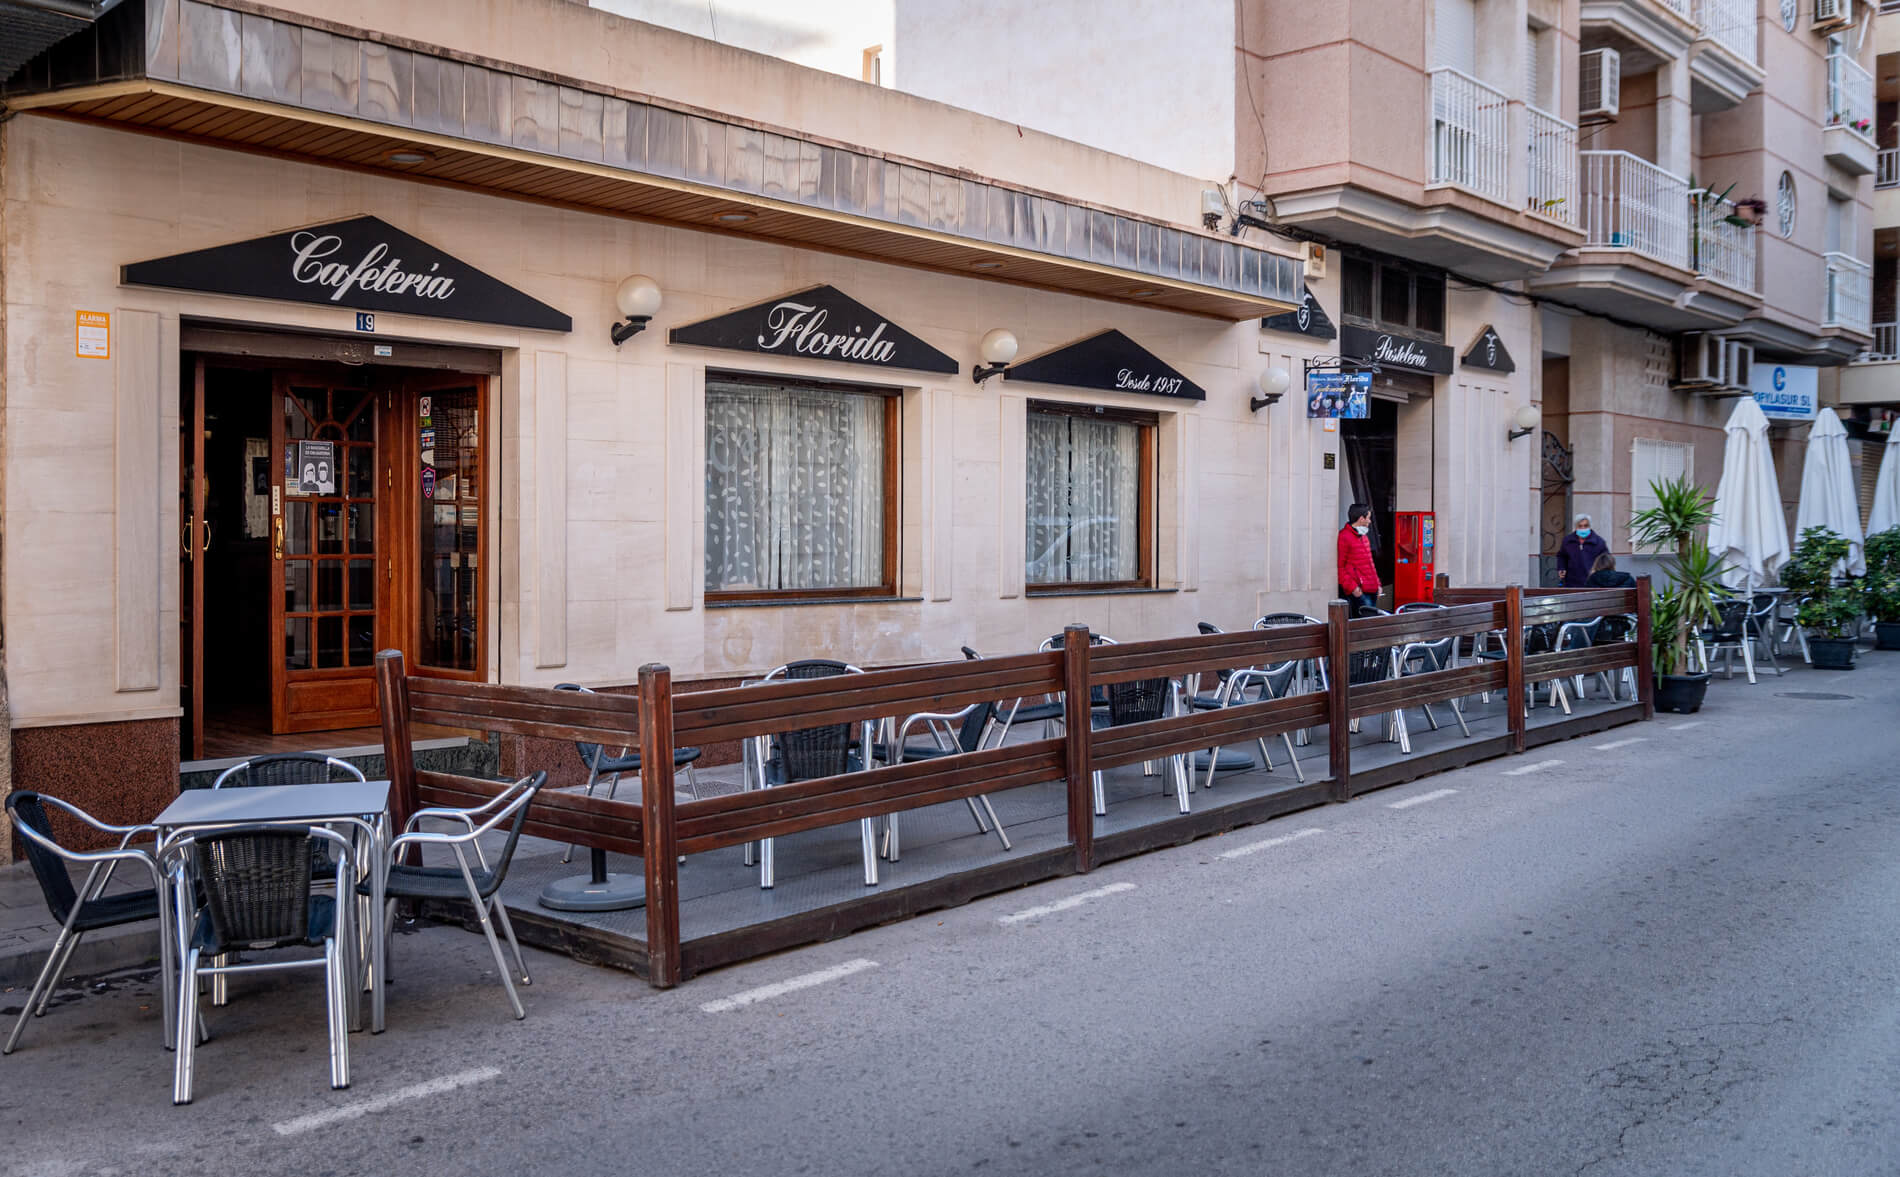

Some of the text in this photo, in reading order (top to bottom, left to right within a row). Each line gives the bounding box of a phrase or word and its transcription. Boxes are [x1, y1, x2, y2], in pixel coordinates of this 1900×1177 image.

[358, 315, 374, 331] 19
[758, 301, 896, 362] Florida
[1115, 368, 1184, 394] Desde 1987
